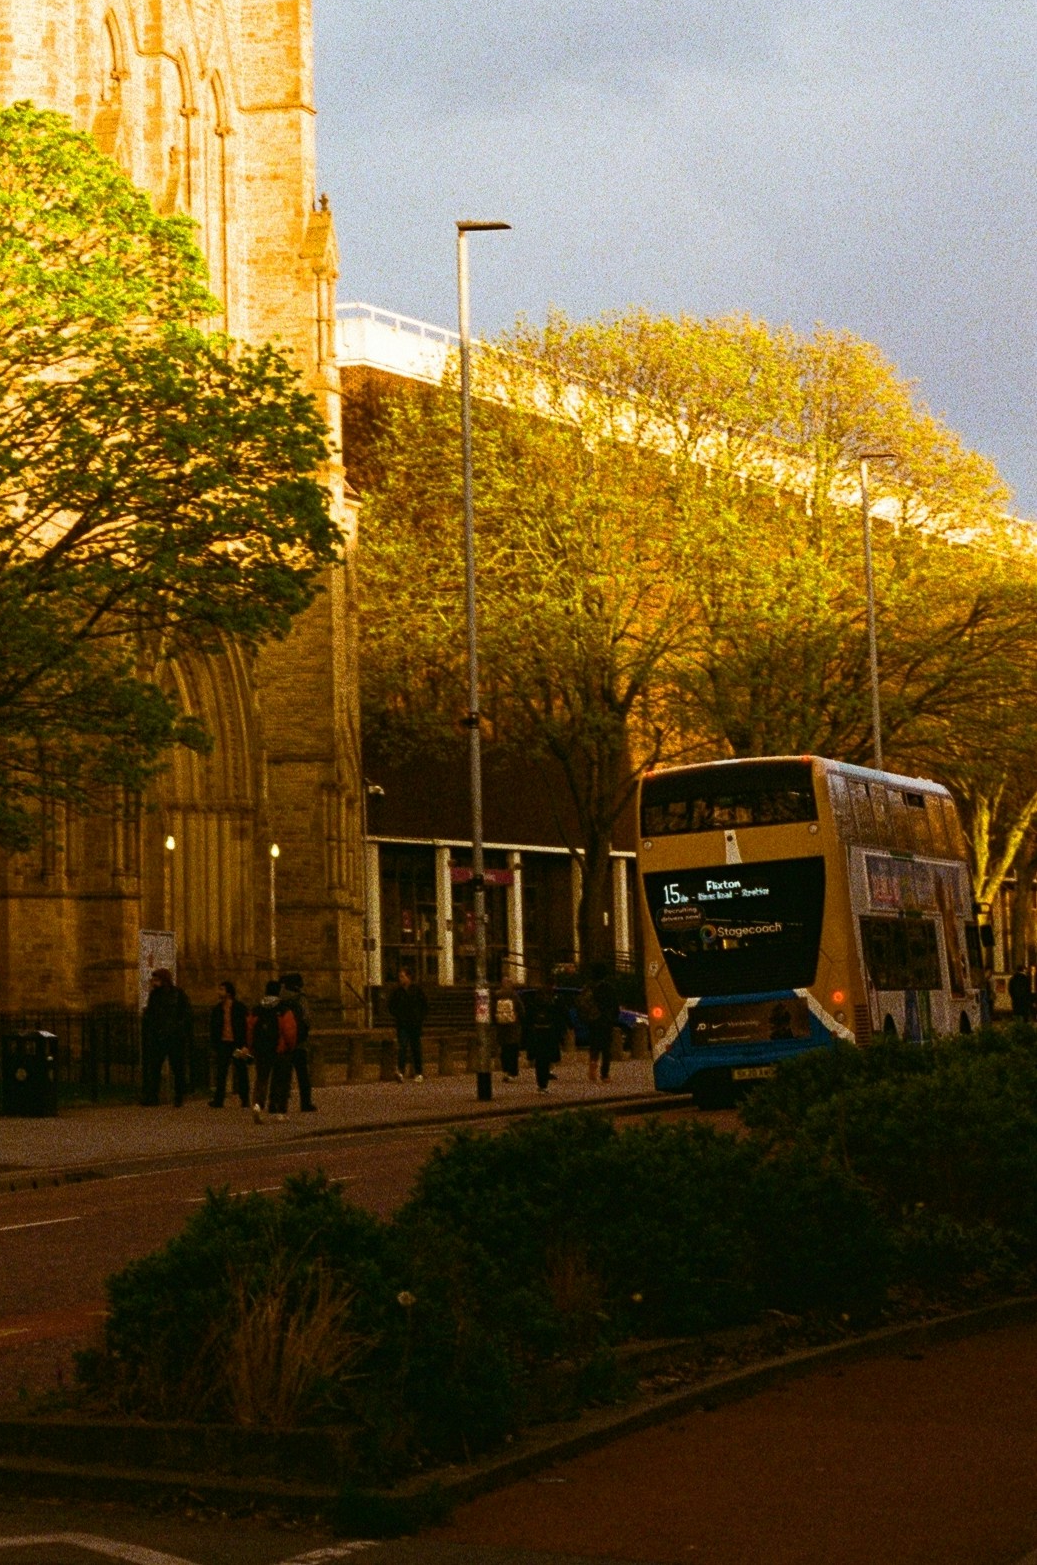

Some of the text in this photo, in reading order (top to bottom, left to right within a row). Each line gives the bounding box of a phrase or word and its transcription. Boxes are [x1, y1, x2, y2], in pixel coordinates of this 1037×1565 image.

[706, 880, 741, 892] Flixton
[663, 883, 680, 905] 15
[664, 906, 698, 914] Recruiting
[660, 915, 684, 923] drivers
[717, 922, 782, 938] Stagecoach
